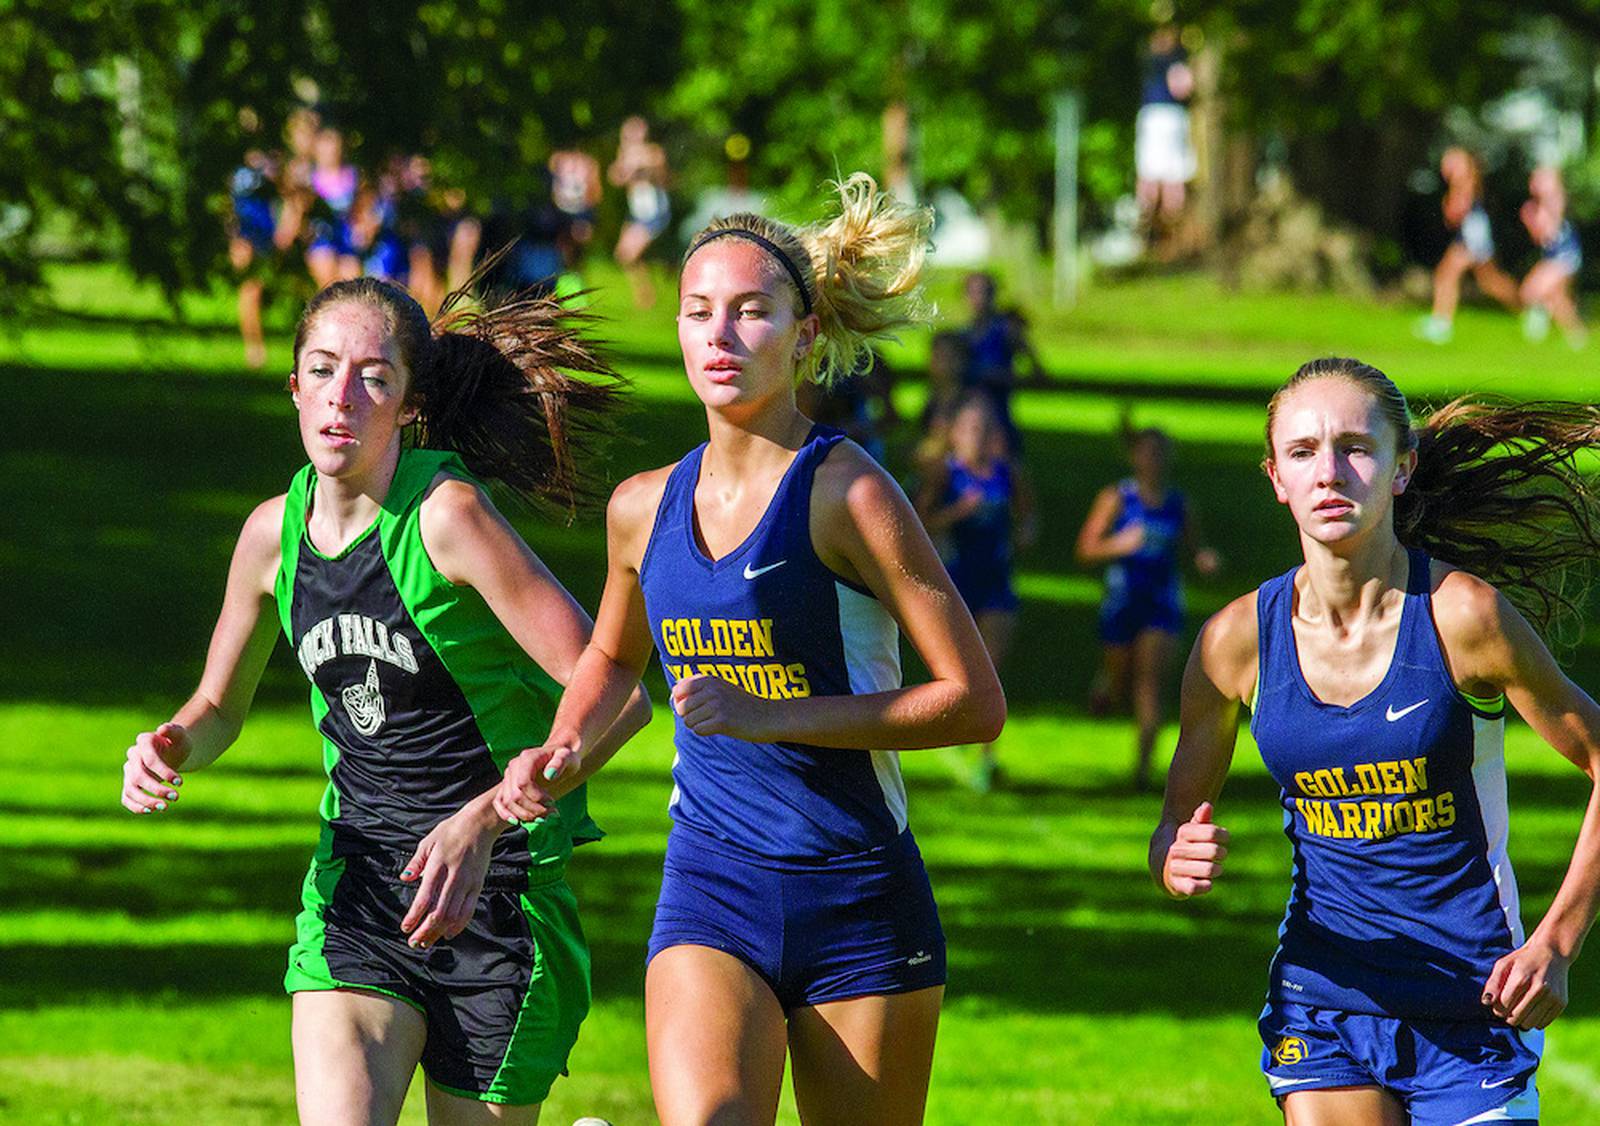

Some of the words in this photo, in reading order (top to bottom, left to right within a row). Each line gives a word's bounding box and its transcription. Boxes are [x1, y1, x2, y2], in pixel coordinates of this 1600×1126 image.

[298, 617, 337, 683] OCK
[338, 614, 419, 674] FALLS
[661, 618, 775, 657] GOLDEN
[1294, 757, 1428, 797] GOLDEN
[1295, 791, 1456, 839] WARRIORS
